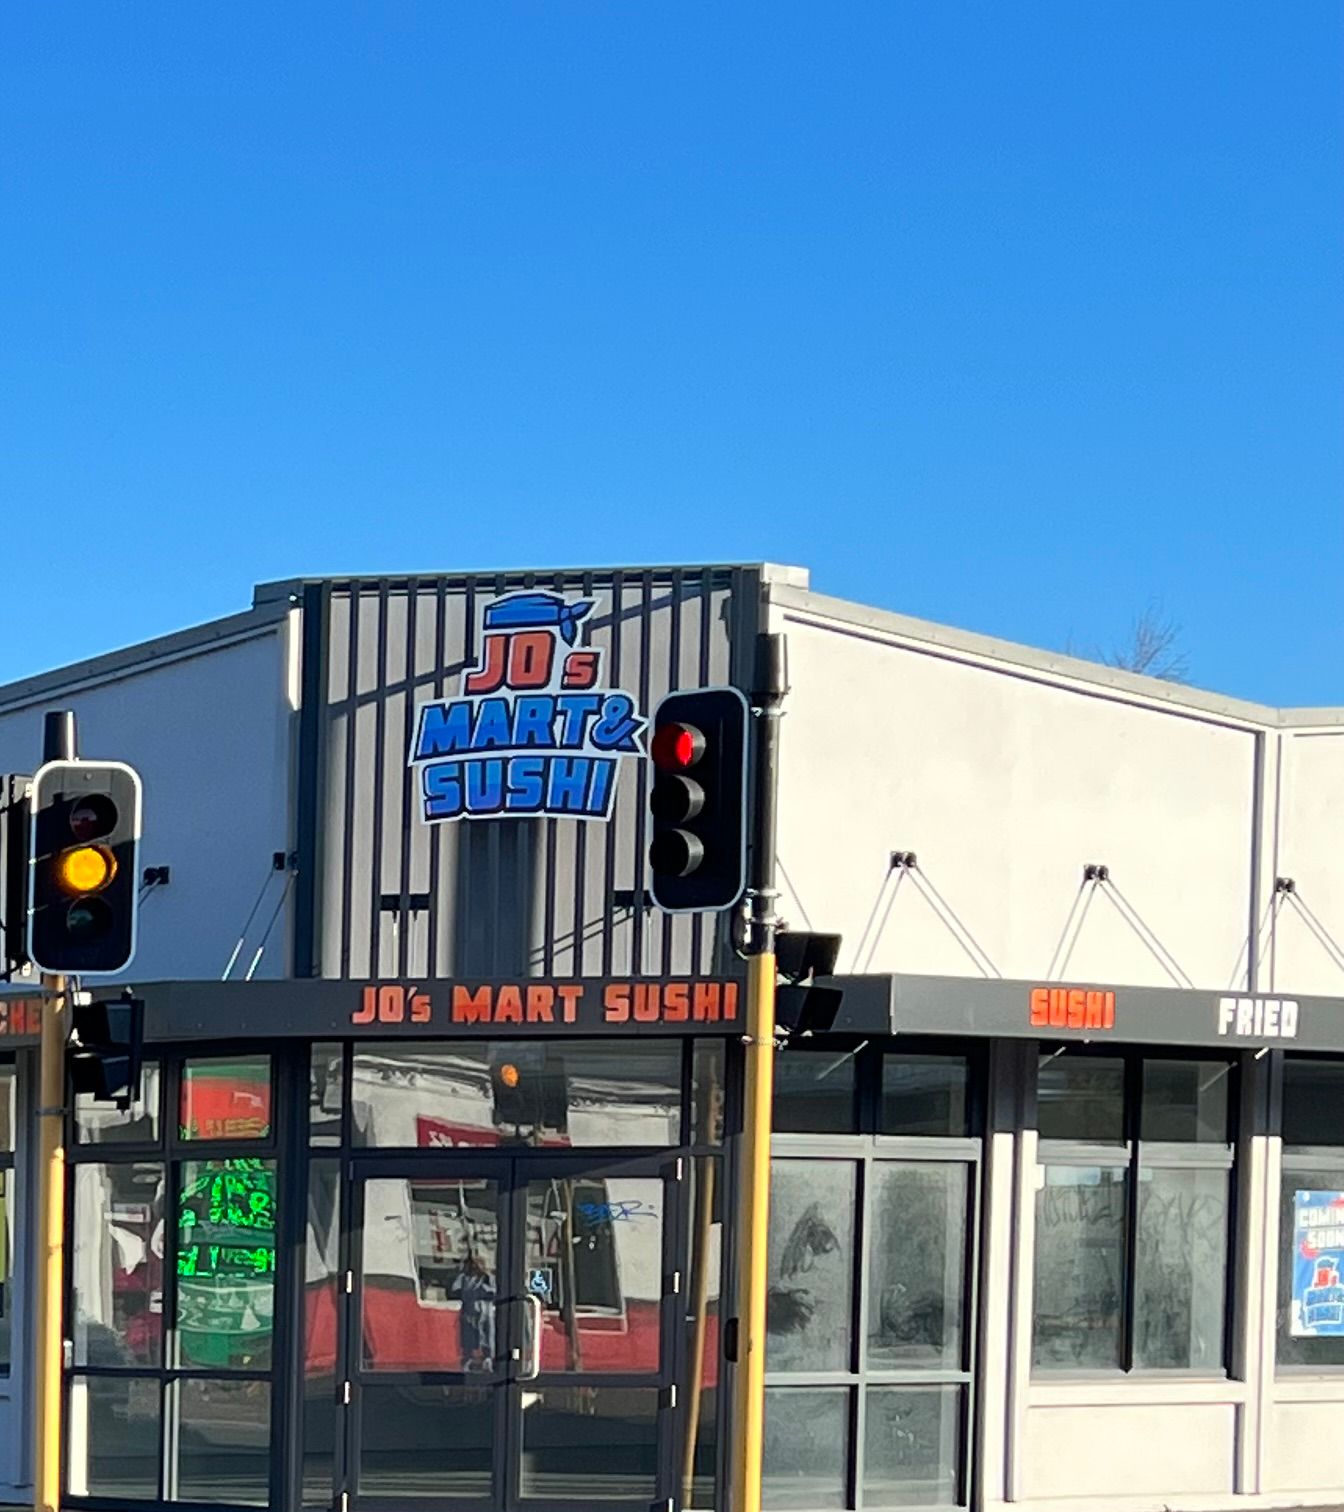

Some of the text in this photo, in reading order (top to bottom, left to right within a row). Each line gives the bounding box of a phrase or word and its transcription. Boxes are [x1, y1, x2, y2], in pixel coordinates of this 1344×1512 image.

[424, 755, 616, 819] SUSHI
[352, 982, 738, 1024] JO's MART SUSHI
[1029, 987, 1299, 1039] SUSHI FRIED
[1299, 1206, 1344, 1228] COMIN
